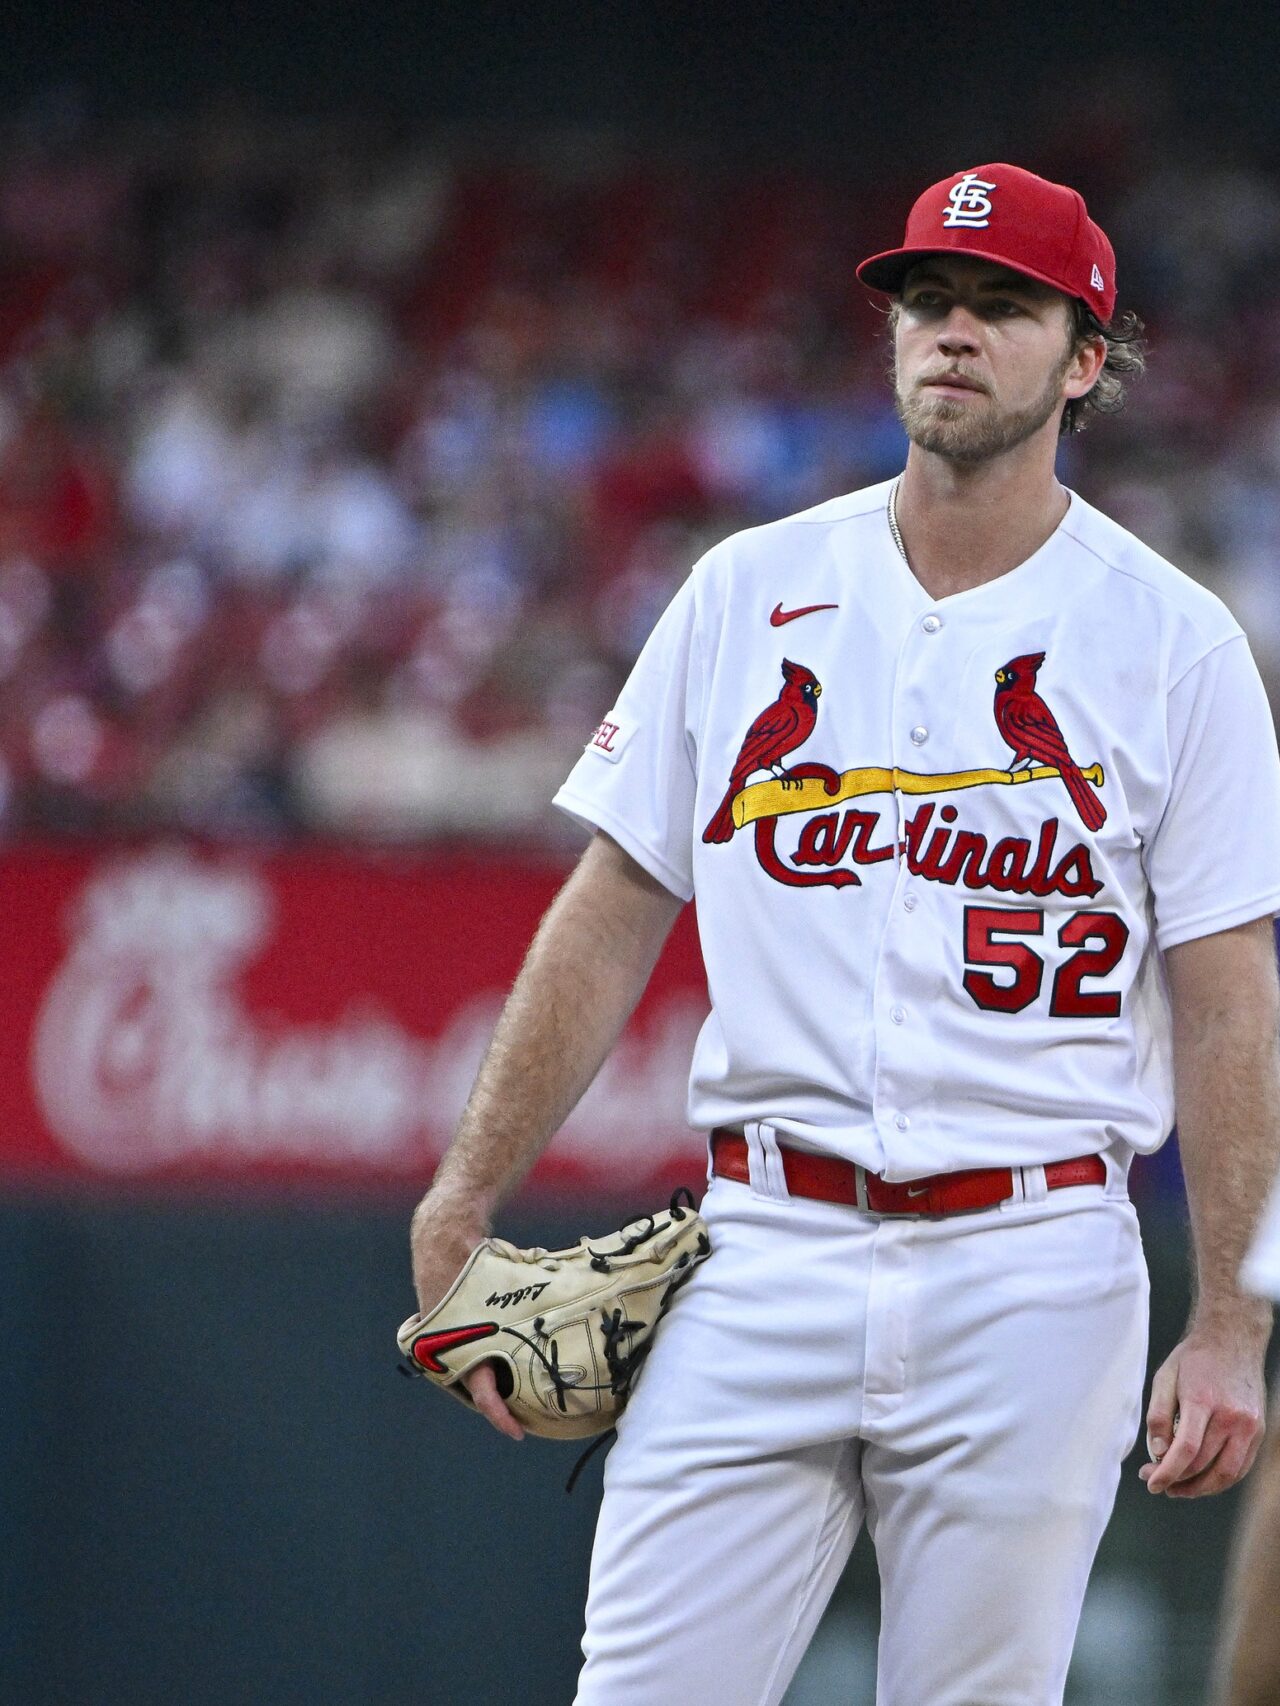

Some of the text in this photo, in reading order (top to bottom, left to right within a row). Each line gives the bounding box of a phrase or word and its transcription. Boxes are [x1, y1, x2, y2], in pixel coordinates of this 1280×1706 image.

[593, 720, 620, 753] EL
[753, 762, 1105, 899] Cardinals
[962, 904, 1130, 1019] 52
[484, 1280, 552, 1310] Libby
